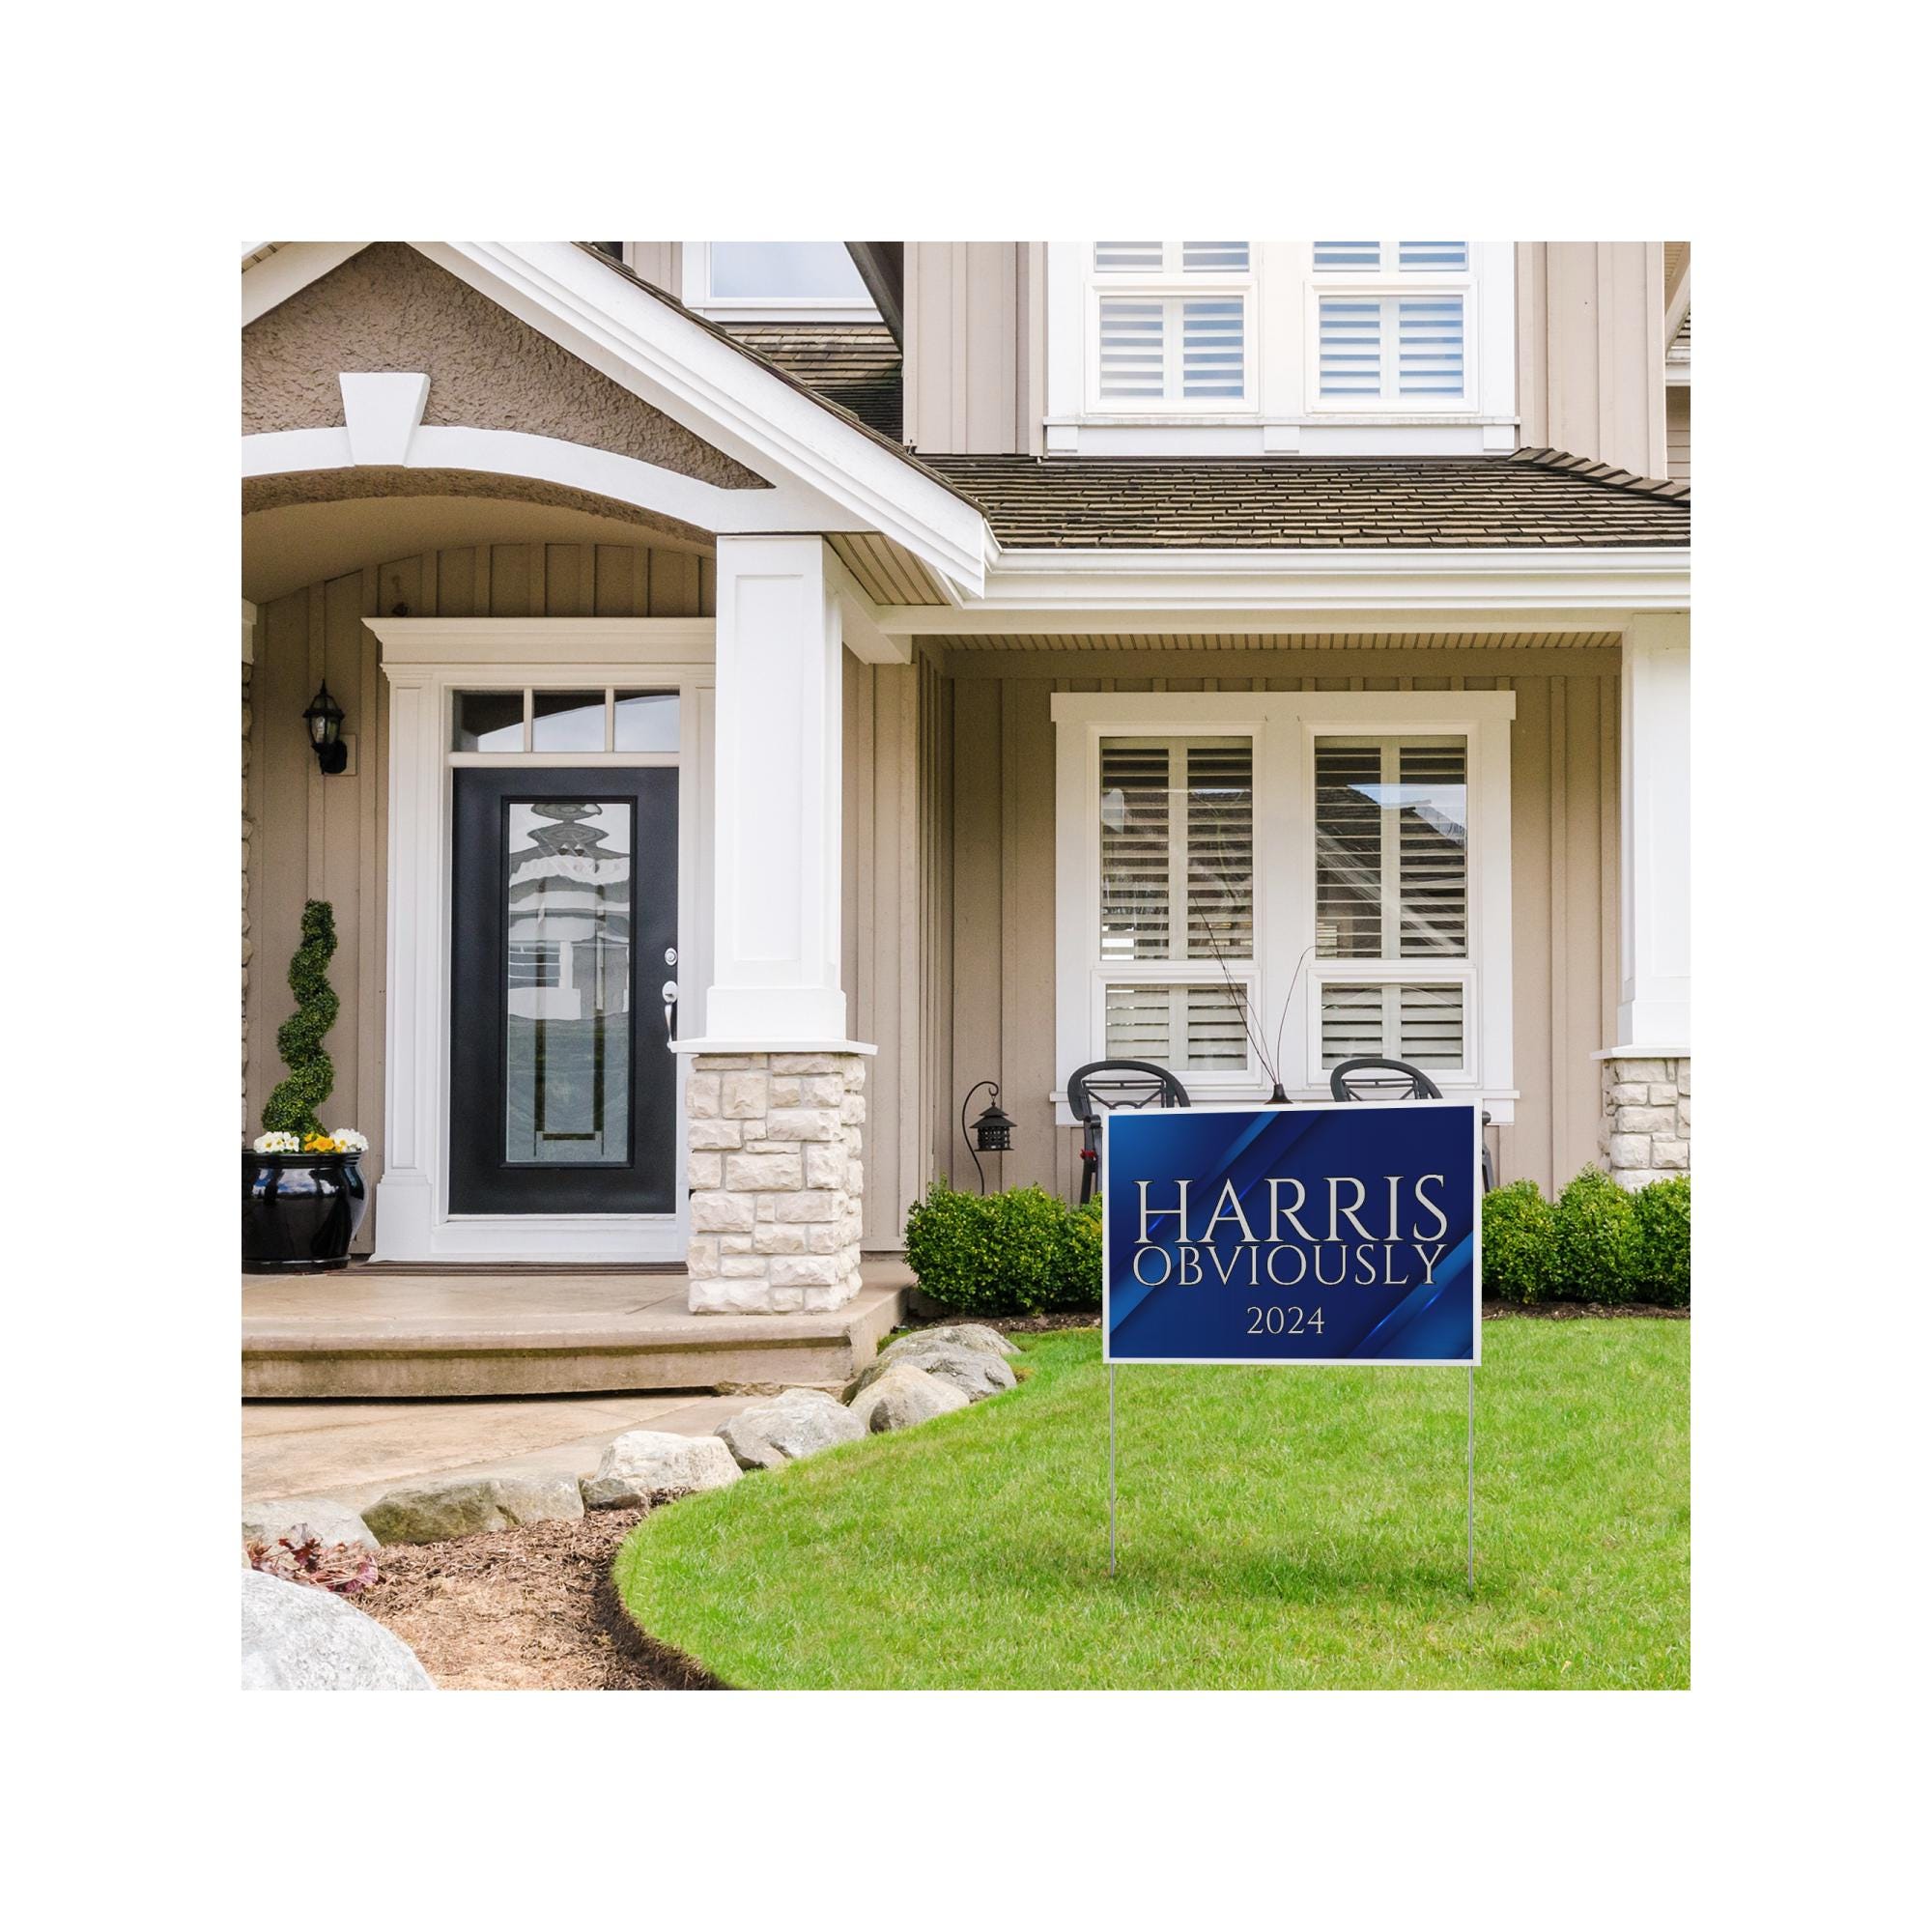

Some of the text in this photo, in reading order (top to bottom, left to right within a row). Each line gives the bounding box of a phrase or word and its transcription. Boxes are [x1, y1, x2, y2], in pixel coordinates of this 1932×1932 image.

[1133, 1174, 1448, 1244] HARRIS
[1133, 1243, 1448, 1287] OBVIOUSLY
[1246, 1306, 1325, 1334] 2024
